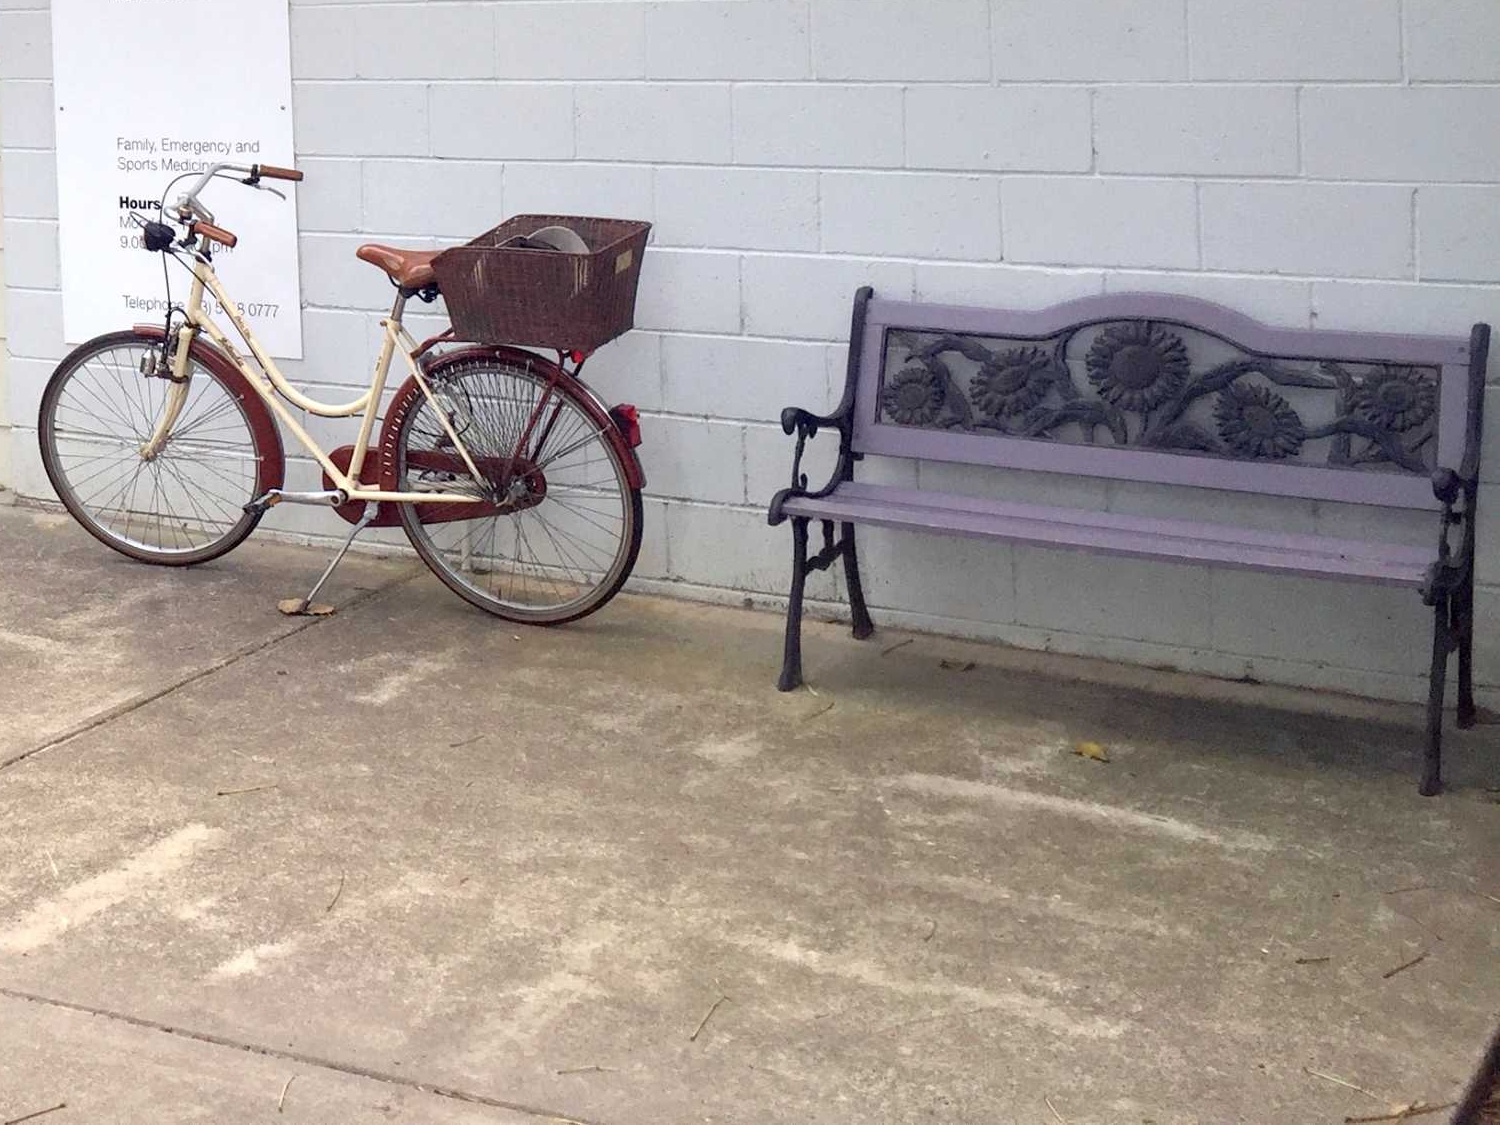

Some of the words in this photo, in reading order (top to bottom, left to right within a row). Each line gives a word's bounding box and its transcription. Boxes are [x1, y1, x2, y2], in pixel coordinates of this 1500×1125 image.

[117, 138, 157, 154] Family,
[161, 138, 232, 155] Emergency
[236, 140, 260, 153] and
[117, 157, 158, 172] Sports
[120, 196, 161, 210] Hours
[248, 302, 279, 318] 0777
